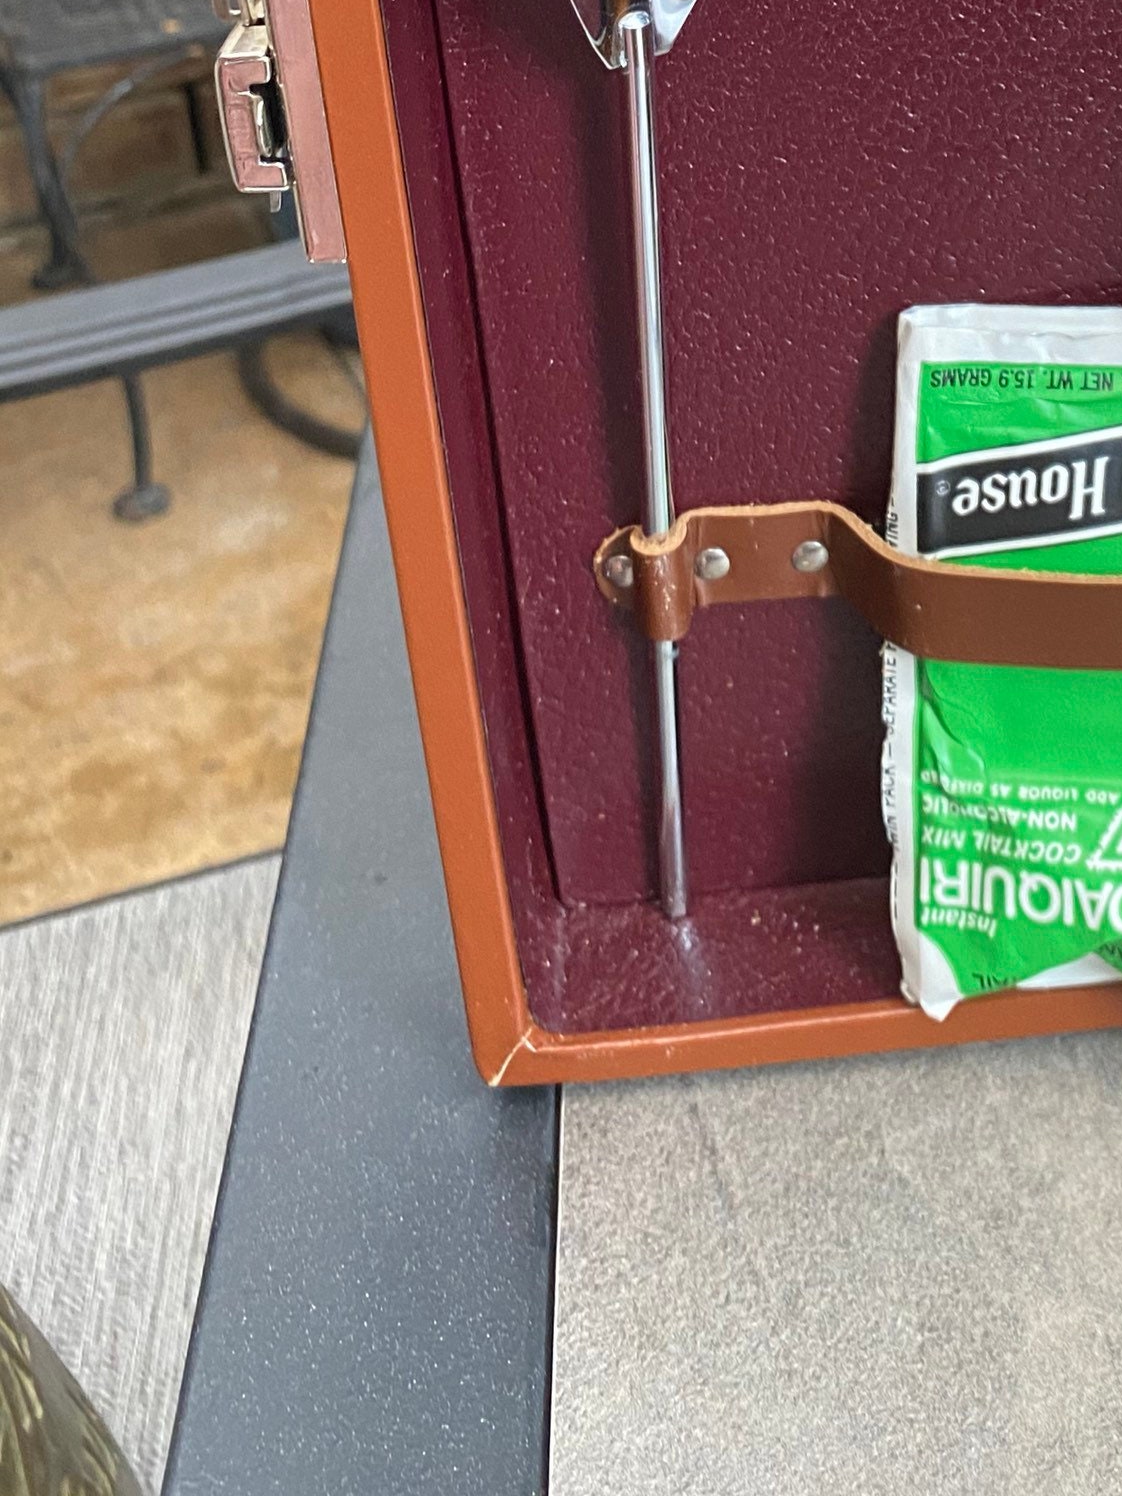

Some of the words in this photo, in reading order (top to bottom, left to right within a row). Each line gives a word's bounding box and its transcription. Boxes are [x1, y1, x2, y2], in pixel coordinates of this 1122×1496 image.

[929, 368, 992, 388] GRAMS
[998, 368, 1034, 390] 15.9
[1043, 369, 1073, 391] WT.
[1080, 371, 1114, 391] NET
[990, 782, 1013, 799] AS
[1019, 784, 1079, 803] LIQUOR
[1084, 790, 1121, 806] ADD
[922, 825, 967, 850] MIX
[972, 828, 1081, 865] COCKTAIL
[921, 906, 998, 938] Instant
